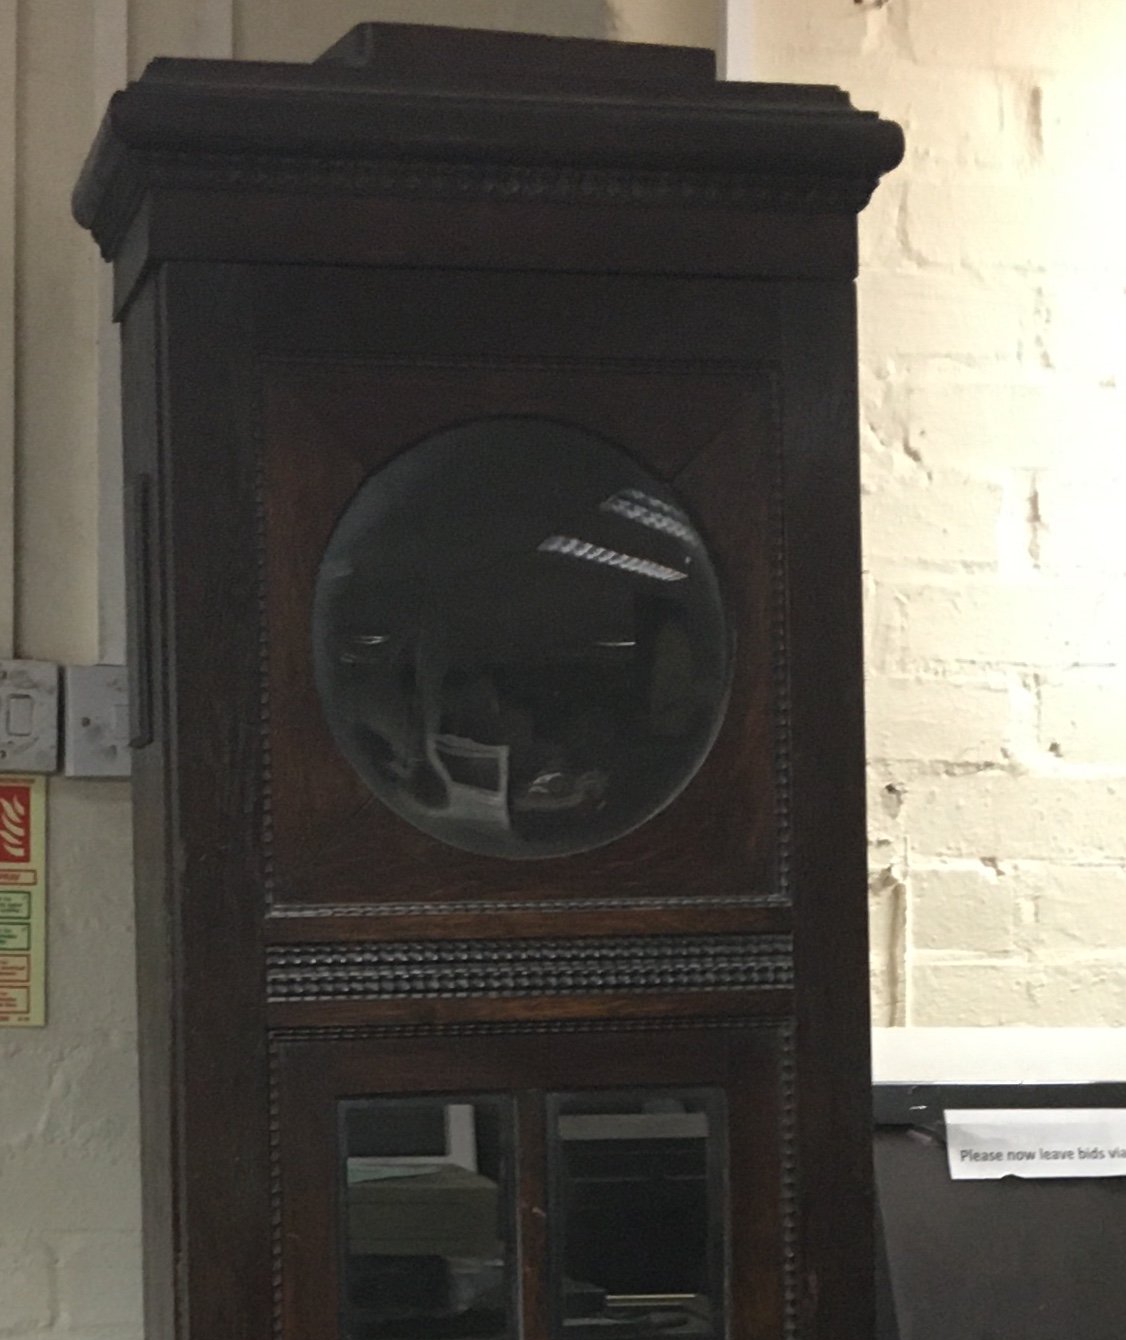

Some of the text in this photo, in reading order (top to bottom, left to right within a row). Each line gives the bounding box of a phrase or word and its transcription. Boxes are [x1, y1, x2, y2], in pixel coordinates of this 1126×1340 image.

[959, 1149, 1004, 1162] Please
[1006, 1150, 1035, 1161] now
[1039, 1148, 1075, 1160] leave
[1077, 1147, 1105, 1160] bids
